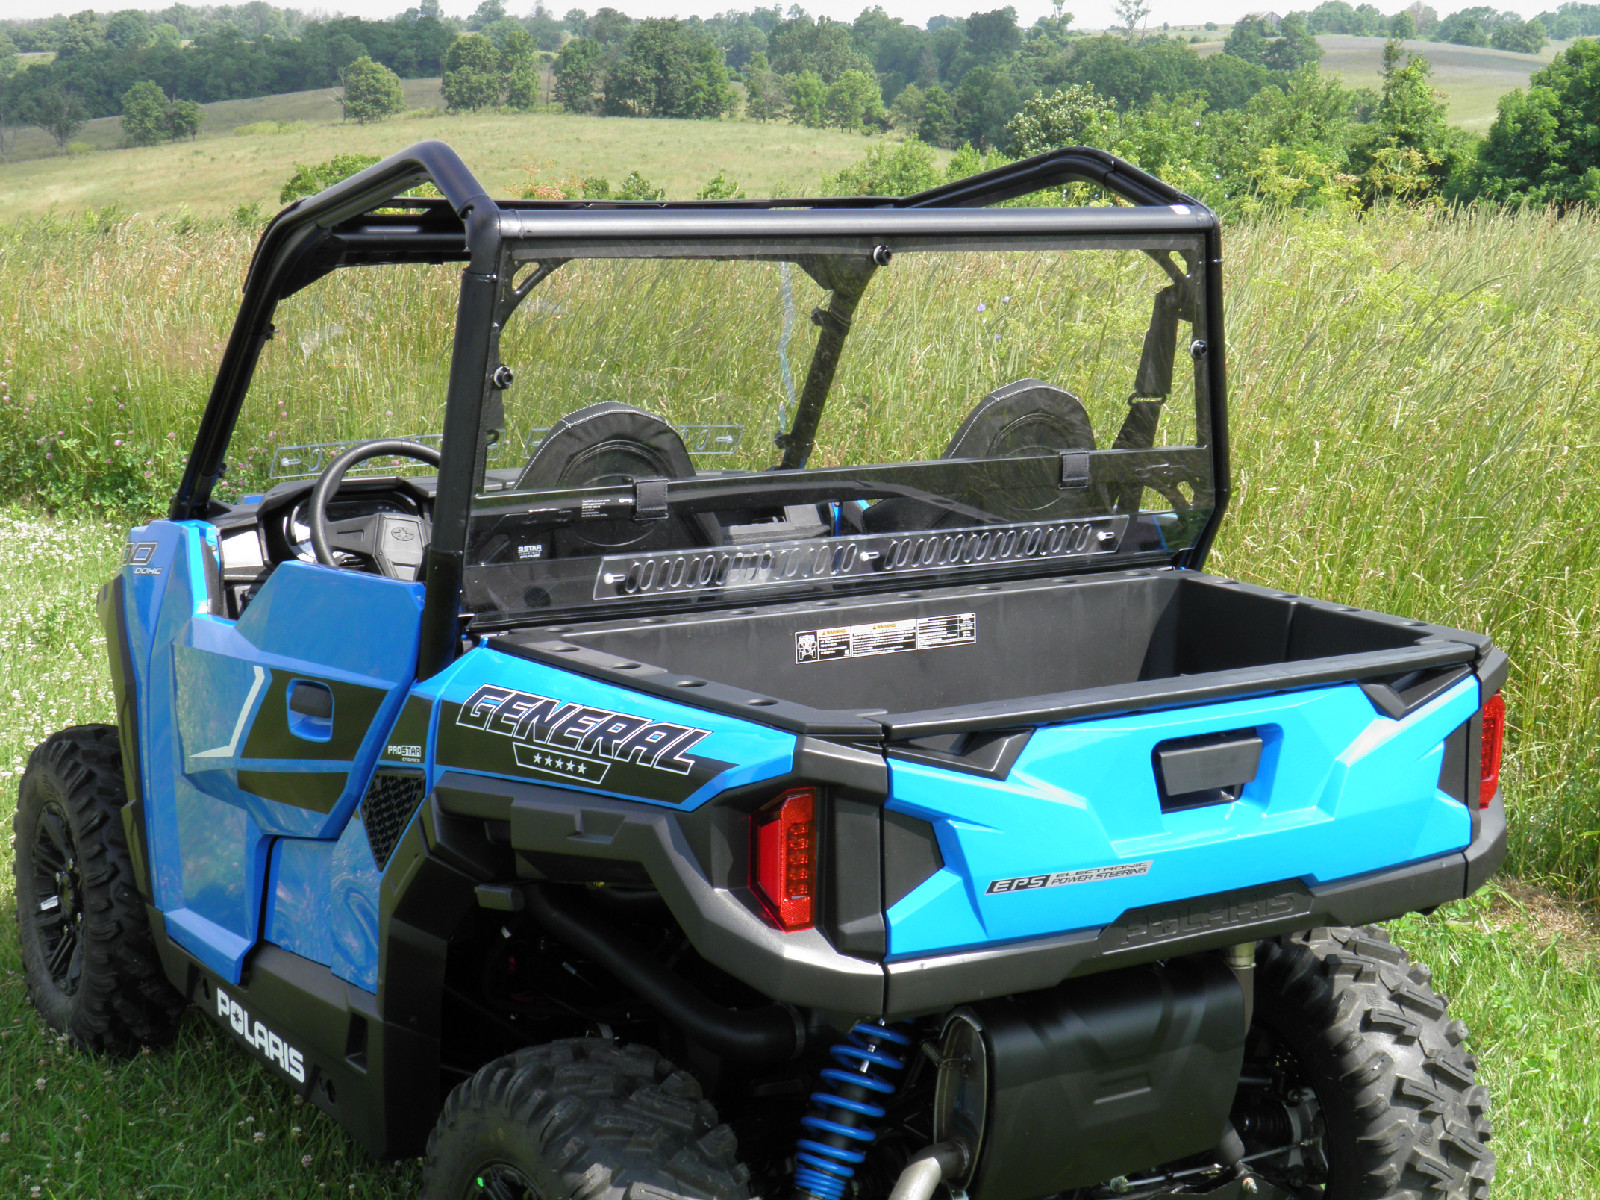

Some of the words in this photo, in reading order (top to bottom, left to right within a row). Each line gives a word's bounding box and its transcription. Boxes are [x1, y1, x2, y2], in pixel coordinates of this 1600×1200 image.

[456, 683, 713, 776] GENERAL
[387, 745, 422, 757] PROSTAR
[992, 875, 1047, 893] EPS
[1056, 862, 1148, 877] ELECTRONIC
[1051, 874, 1092, 885] POWER
[1095, 867, 1148, 880] STEERING
[1120, 891, 1295, 945] POLARIS
[217, 987, 305, 1083] POLARIS
